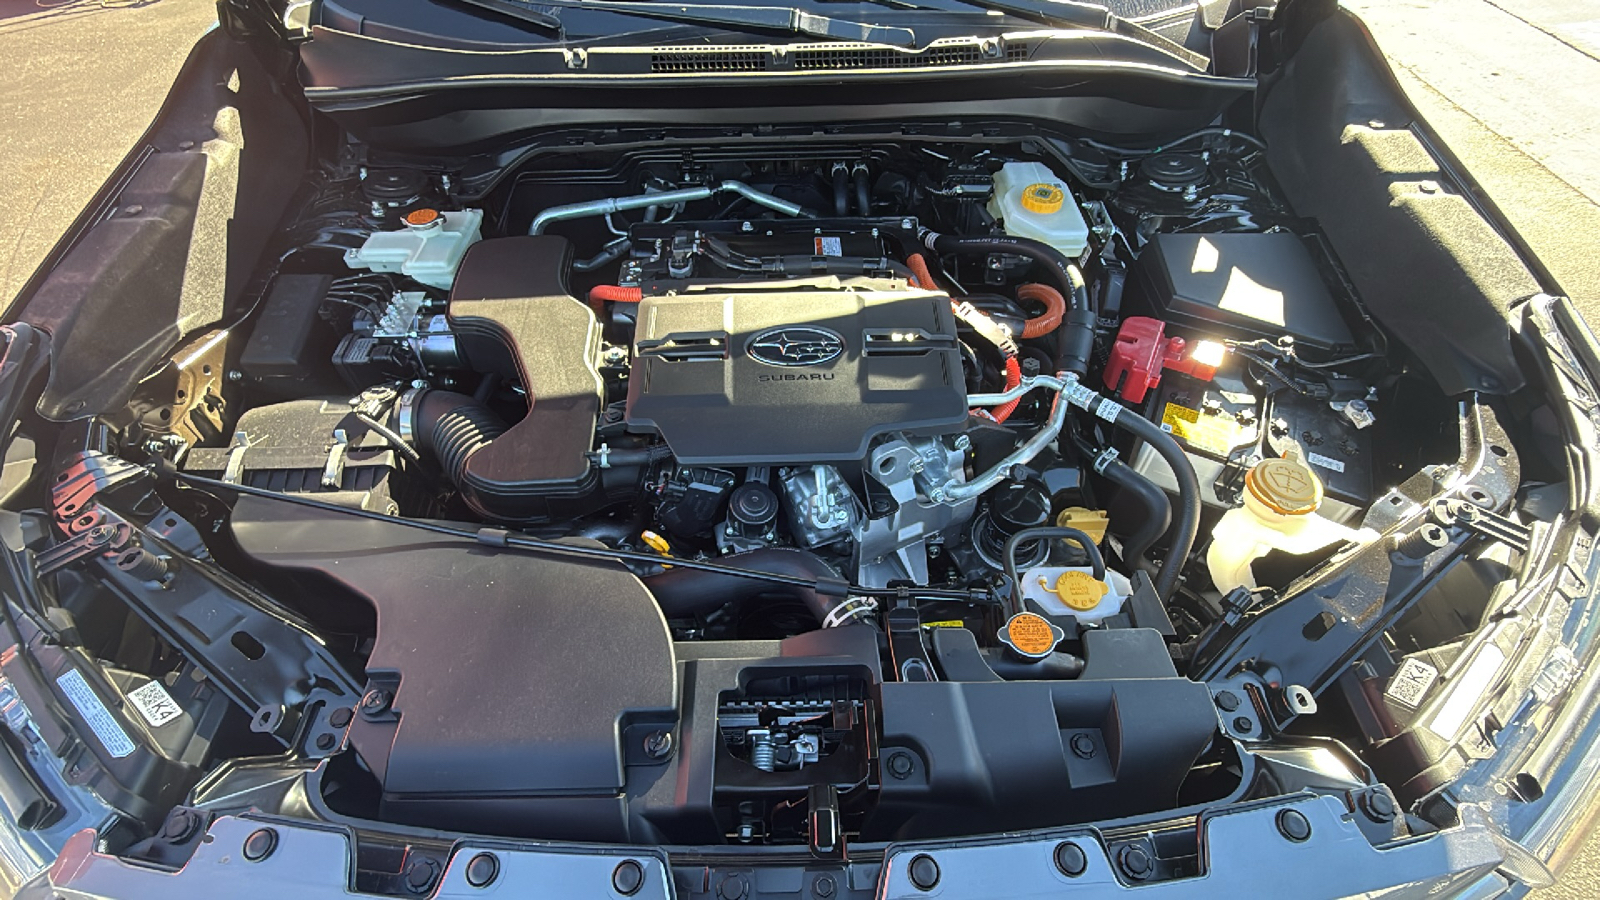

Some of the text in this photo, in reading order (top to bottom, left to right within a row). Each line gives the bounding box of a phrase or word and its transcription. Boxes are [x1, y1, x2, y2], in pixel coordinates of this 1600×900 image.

[758, 373, 835, 382] SUBARU
[1406, 664, 1428, 684] K4
[151, 698, 174, 721] K4
